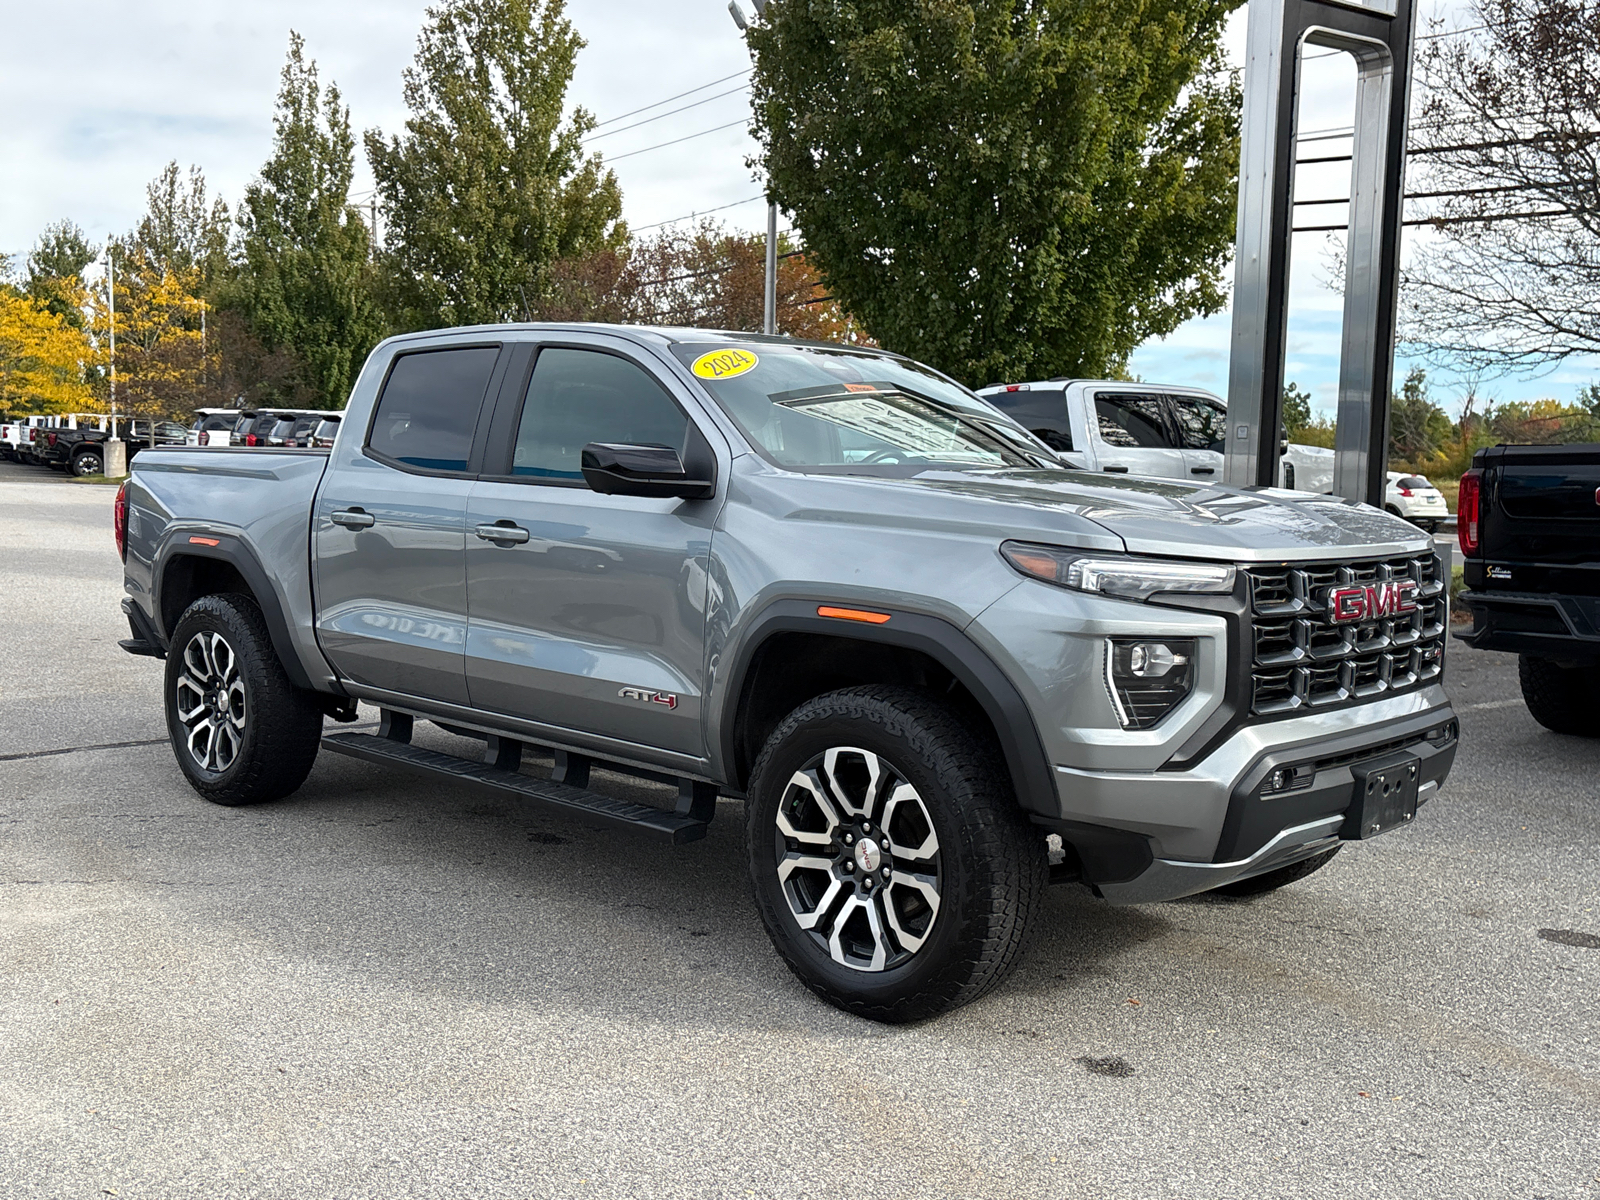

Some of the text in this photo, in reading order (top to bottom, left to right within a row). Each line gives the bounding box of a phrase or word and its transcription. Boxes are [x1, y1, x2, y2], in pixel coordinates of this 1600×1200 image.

[703, 351, 750, 376] 2024
[1331, 580, 1418, 622] GMC
[618, 686, 678, 710] AT4
[860, 840, 873, 870] GMC
